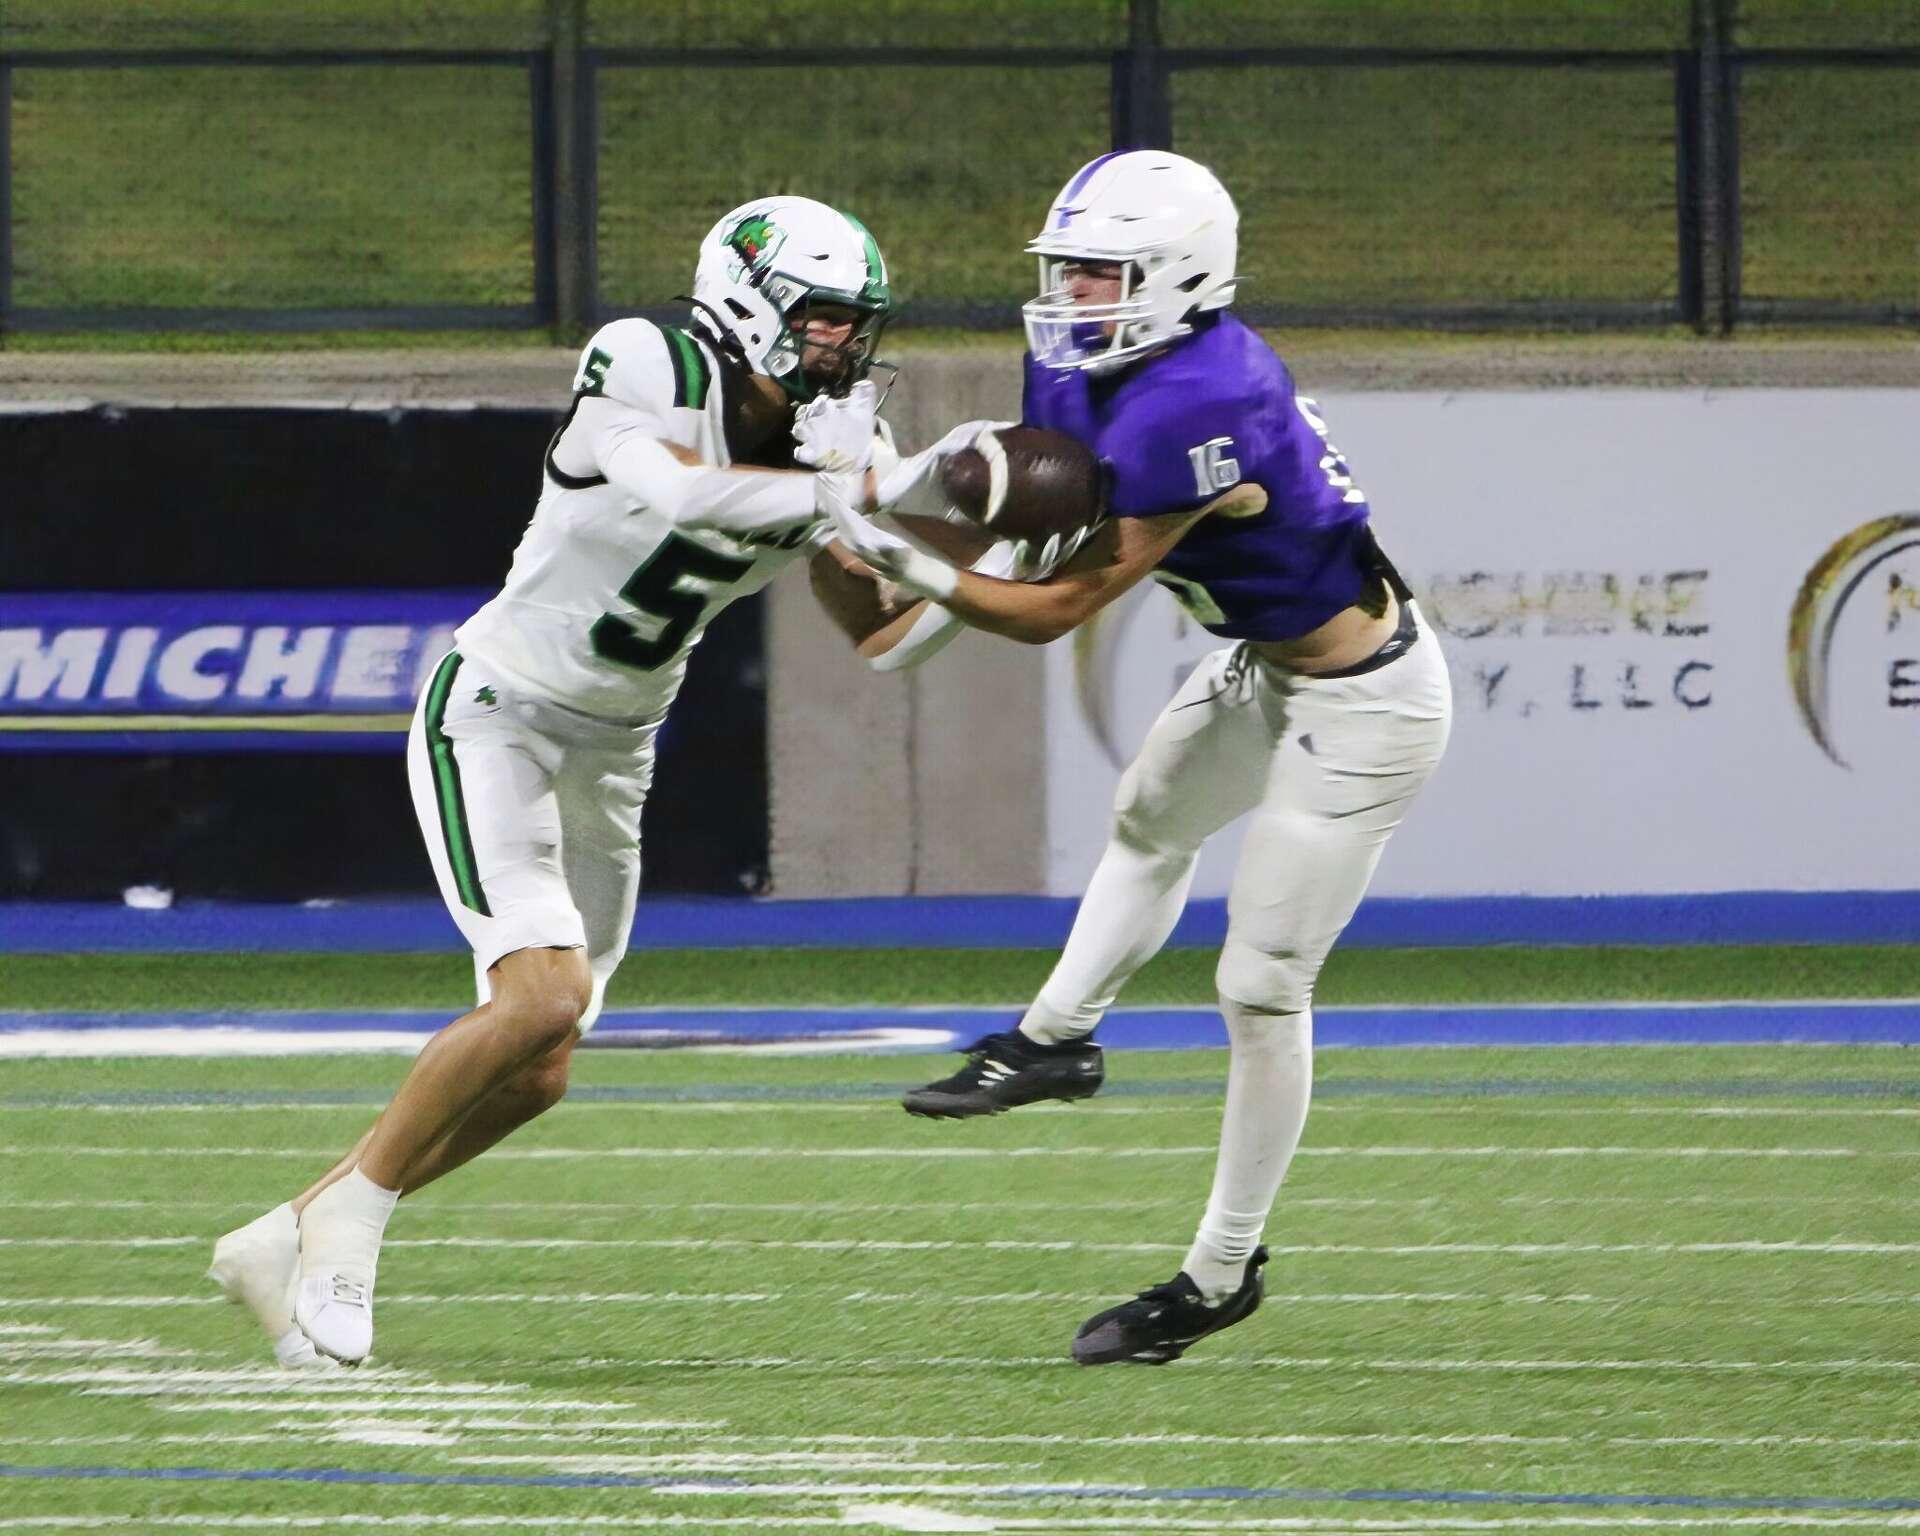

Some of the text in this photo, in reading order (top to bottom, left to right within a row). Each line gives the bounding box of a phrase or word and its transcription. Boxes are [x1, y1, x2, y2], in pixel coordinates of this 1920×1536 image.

[577, 347, 614, 396] 5
[1188, 436, 1241, 496] 16
[588, 528, 757, 672] 5
[1570, 661, 1714, 710] LLC
